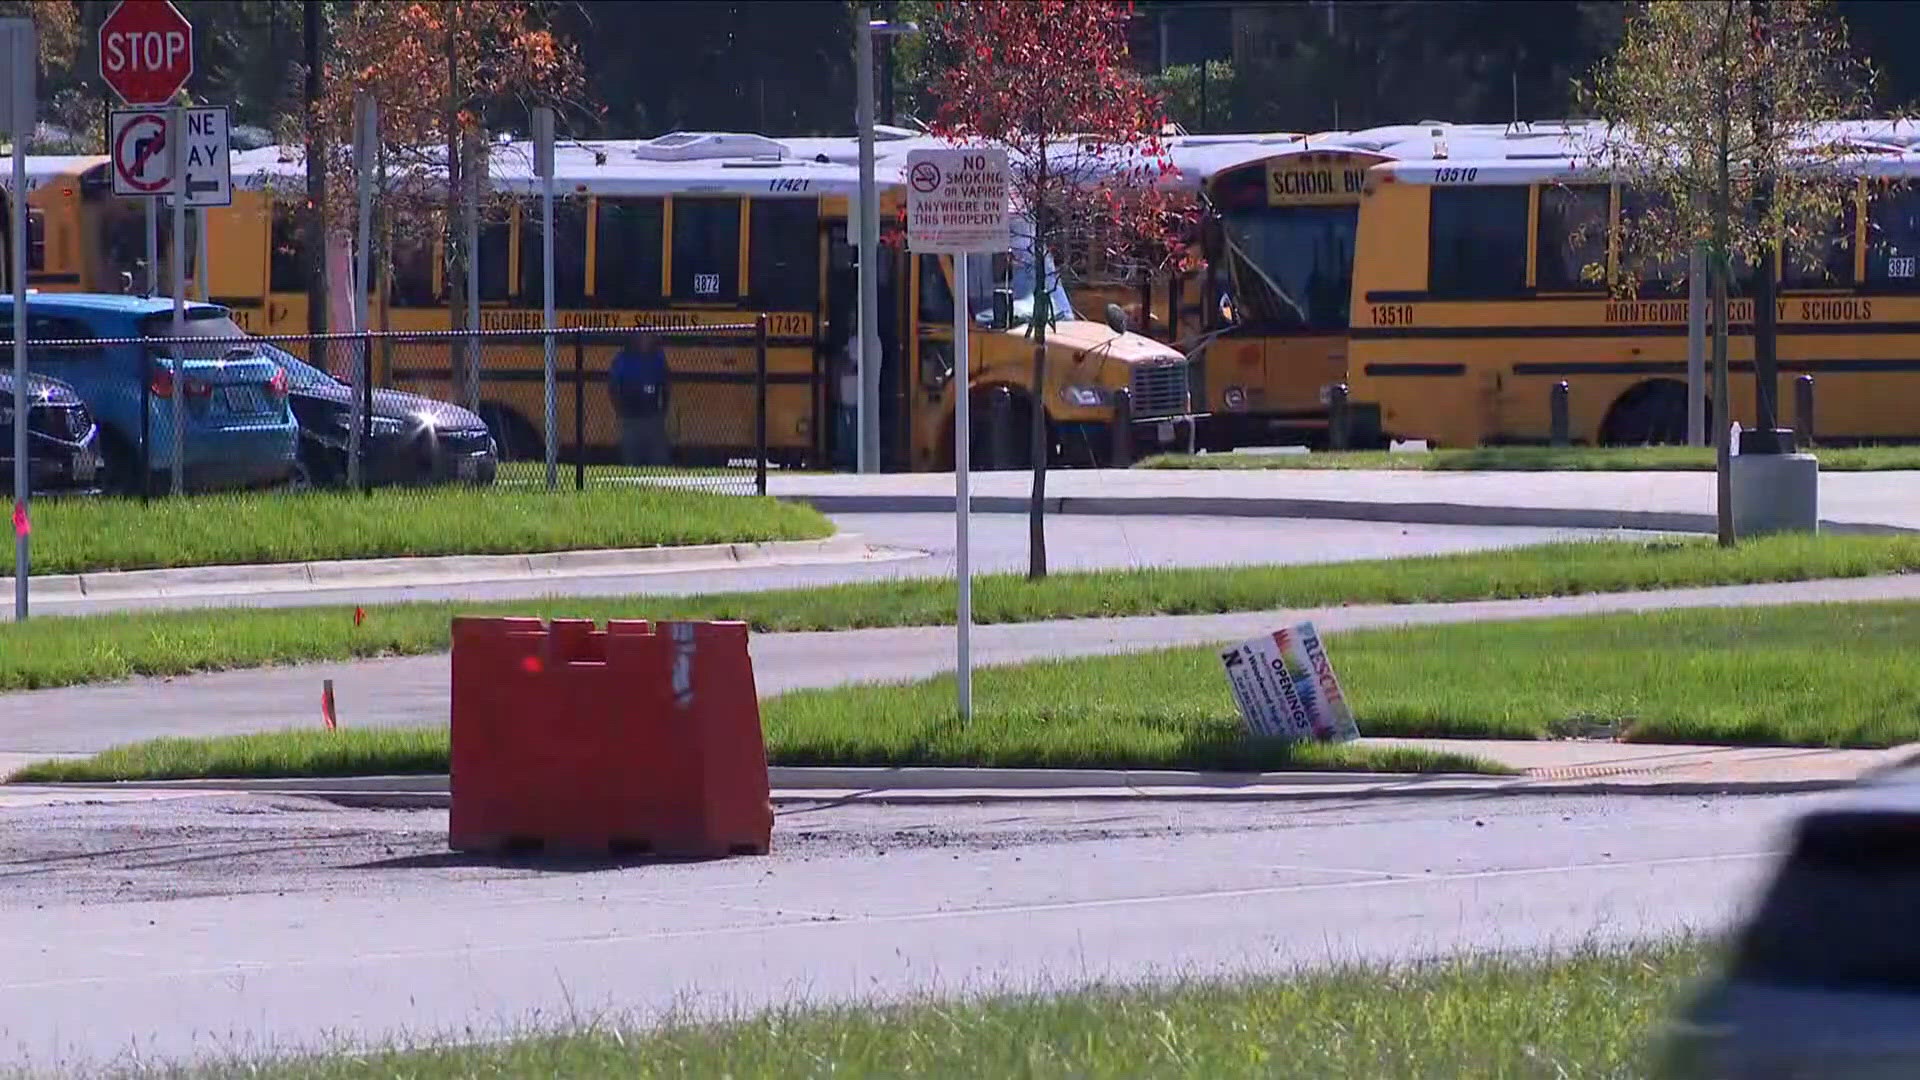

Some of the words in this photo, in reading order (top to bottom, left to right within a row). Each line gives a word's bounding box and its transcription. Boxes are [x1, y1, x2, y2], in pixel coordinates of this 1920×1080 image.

[107, 32, 184, 71] STOP
[188, 113, 214, 136] NE
[187, 145, 217, 167] AY
[963, 155, 985, 171] NO
[946, 172, 1004, 185] SMOKING
[1273, 169, 1334, 194] SCHOOL
[1344, 168, 1364, 194] BU
[1434, 167, 1478, 182] 13510
[769, 179, 809, 192] 17421
[961, 186, 1004, 199] VAPING
[916, 201, 980, 213] ANYWHERE
[983, 200, 1000, 212] ON
[914, 213, 939, 225] THIS
[943, 212, 1001, 225] PROPERTY
[694, 274, 719, 293] 3872
[563, 311, 620, 329] COUNTY
[634, 312, 701, 328] SCHOOLS
[1371, 306, 1413, 325] 13510
[1605, 302, 1712, 322] MONTGOMEY
[1727, 301, 1786, 321] COUY
[1801, 301, 1873, 321] SCHOOLS
[768, 314, 808, 334] 17421
[1221, 649, 1243, 668] N
[1271, 658, 1309, 729] OPENINGS
